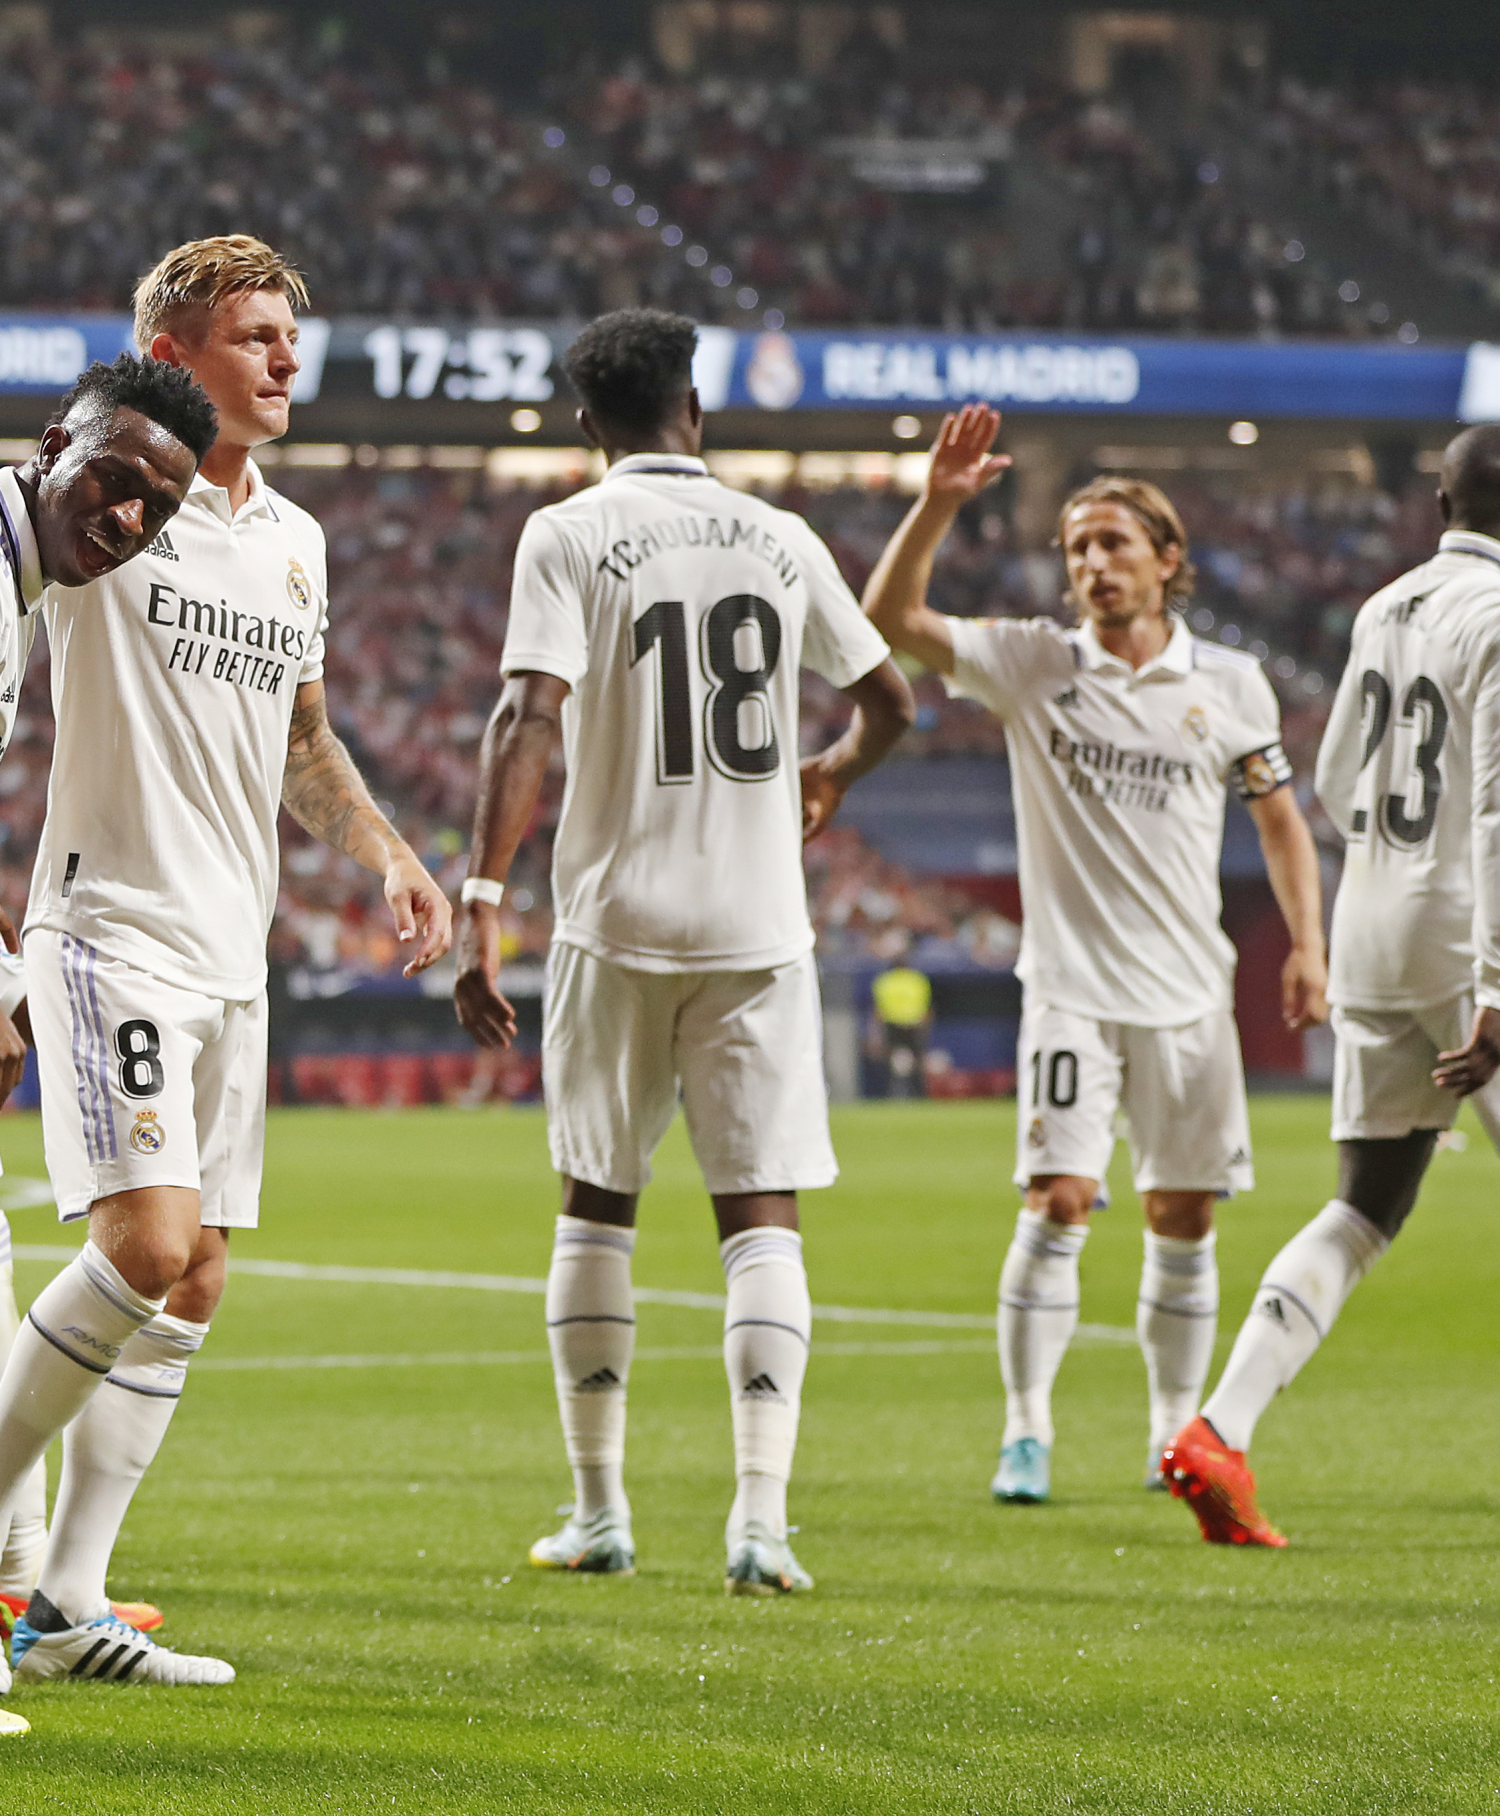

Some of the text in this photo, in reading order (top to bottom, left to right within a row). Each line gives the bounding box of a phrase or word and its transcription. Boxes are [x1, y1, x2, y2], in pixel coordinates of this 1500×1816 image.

[363, 325, 555, 401] 17:52
[822, 341, 1141, 404] REAL MADRID
[143, 543, 180, 563] adidas
[597, 516, 799, 590] TCHOUAMENI
[147, 582, 305, 661] Emirates
[168, 638, 285, 695] FLY BETTER
[629, 594, 783, 787] 18
[1050, 728, 1193, 785] Emirates
[1351, 669, 1448, 852] 23
[113, 1019, 165, 1100] 8
[1031, 1050, 1079, 1109] 10
